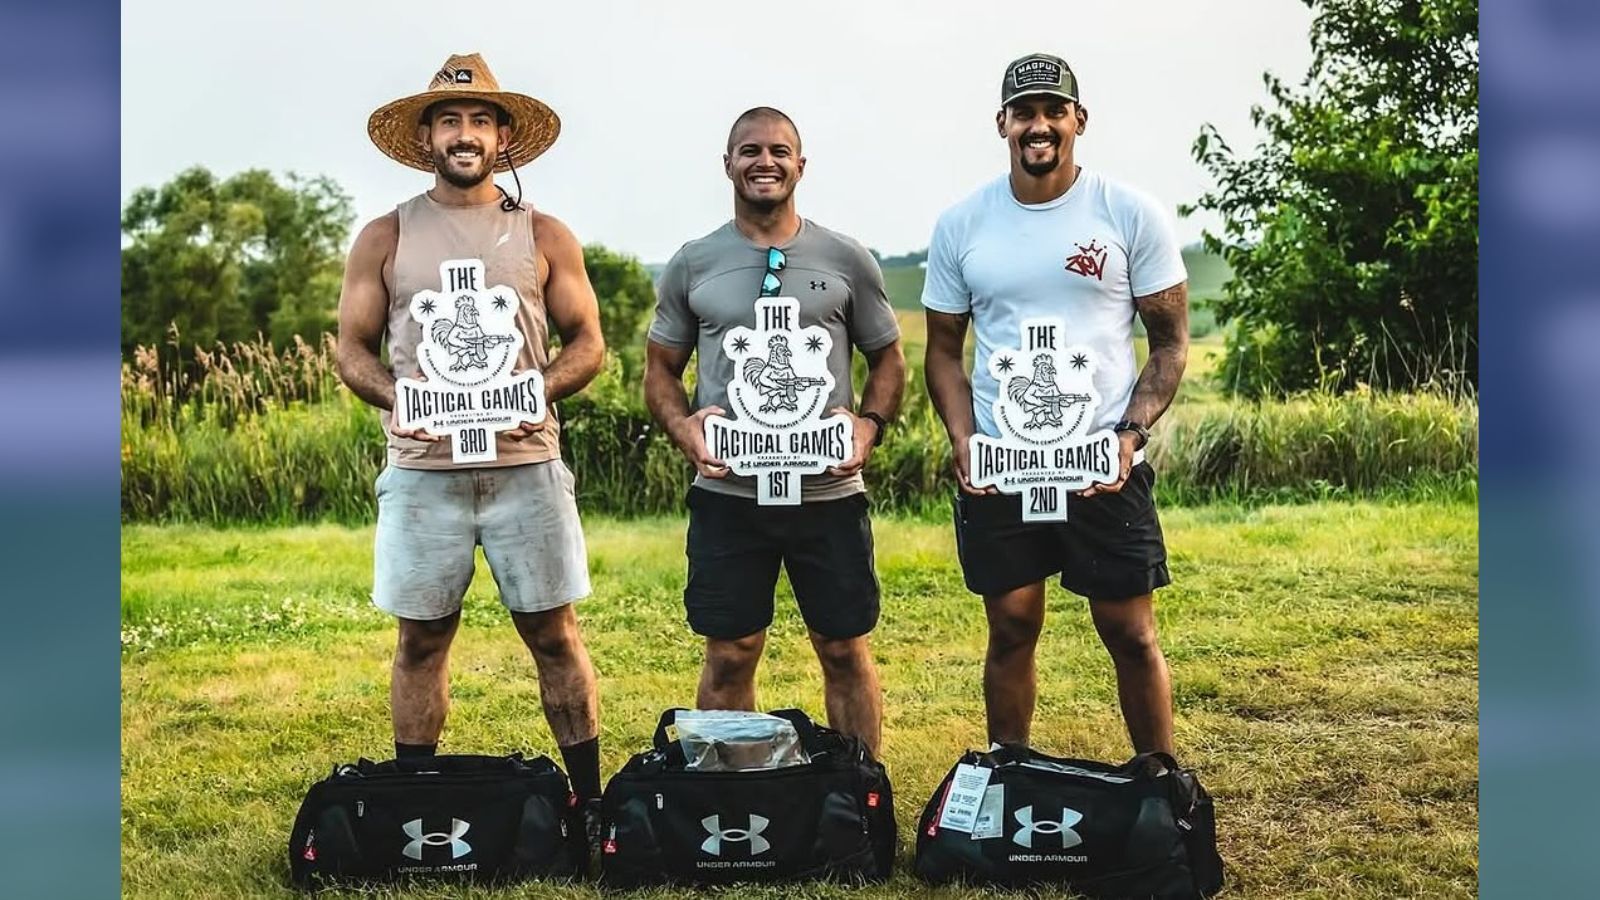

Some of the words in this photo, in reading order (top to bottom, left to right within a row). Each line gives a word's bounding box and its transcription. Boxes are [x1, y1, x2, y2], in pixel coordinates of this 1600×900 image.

[1018, 62, 1057, 73] MAGPUL
[448, 266, 478, 292] THE
[763, 305, 792, 332] THE
[1028, 325, 1057, 351] THE
[403, 385, 475, 423] TACTICAL
[482, 377, 538, 415] GAMES
[460, 428, 488, 454] 3RD
[713, 424, 783, 460] TACTICAL
[789, 422, 845, 460] GAMES
[977, 441, 1048, 480] TACTICAL
[1055, 437, 1110, 476] GAMES
[768, 471, 791, 498] 1ST
[1048, 475, 1083, 483] ARMOUR
[1030, 487, 1057, 513] 2ND
[398, 865, 432, 873] UNDER
[433, 863, 478, 872] ARMOUR
[1008, 854, 1042, 862] UNDER
